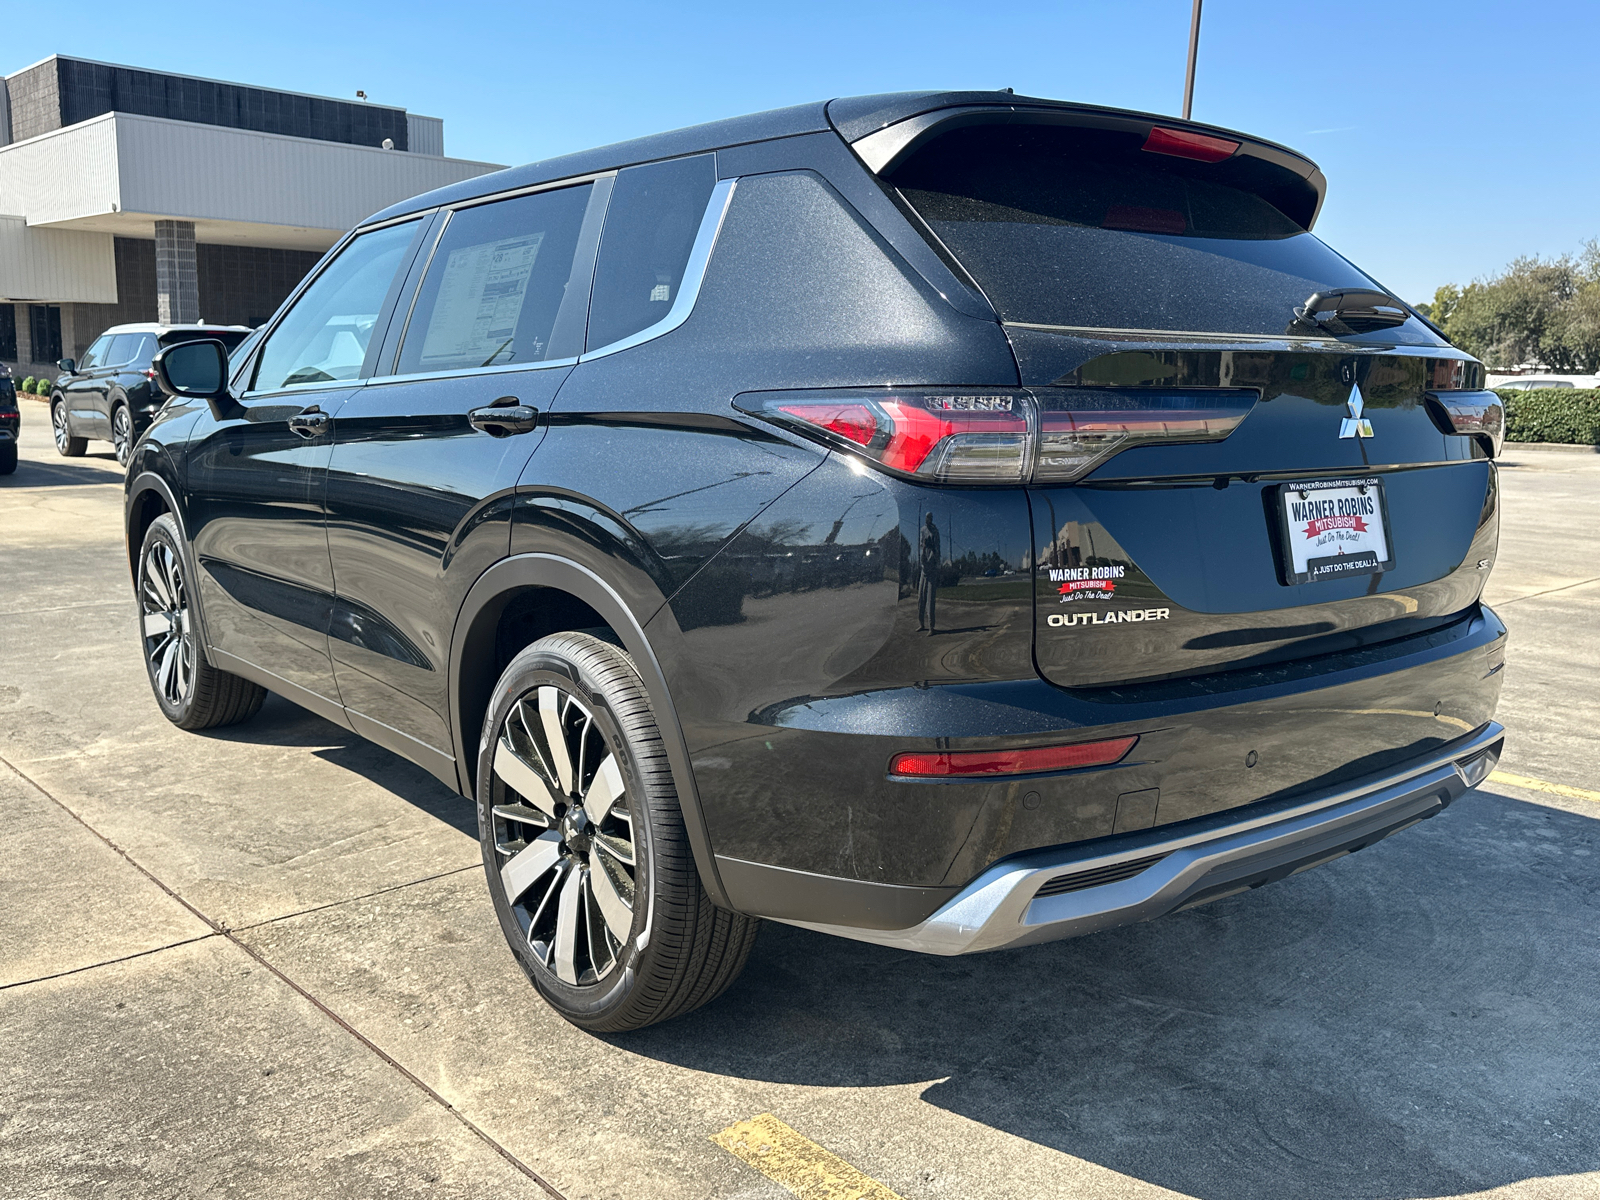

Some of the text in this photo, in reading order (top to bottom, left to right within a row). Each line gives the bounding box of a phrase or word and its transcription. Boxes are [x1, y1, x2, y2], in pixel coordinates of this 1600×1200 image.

[1291, 496, 1374, 522] WARNER ROBINS
[1315, 517, 1356, 532] MITSUBISHI
[1316, 531, 1360, 547] Just Do The Deal!
[1049, 565, 1125, 582] WARNER ROBINS
[1319, 560, 1372, 573] JUST DO THE DEAL!
[1069, 581, 1107, 590] MITSUBISHI
[1060, 590, 1114, 603] Just Do The Deal!
[1047, 607, 1170, 627] OUTLANDER
